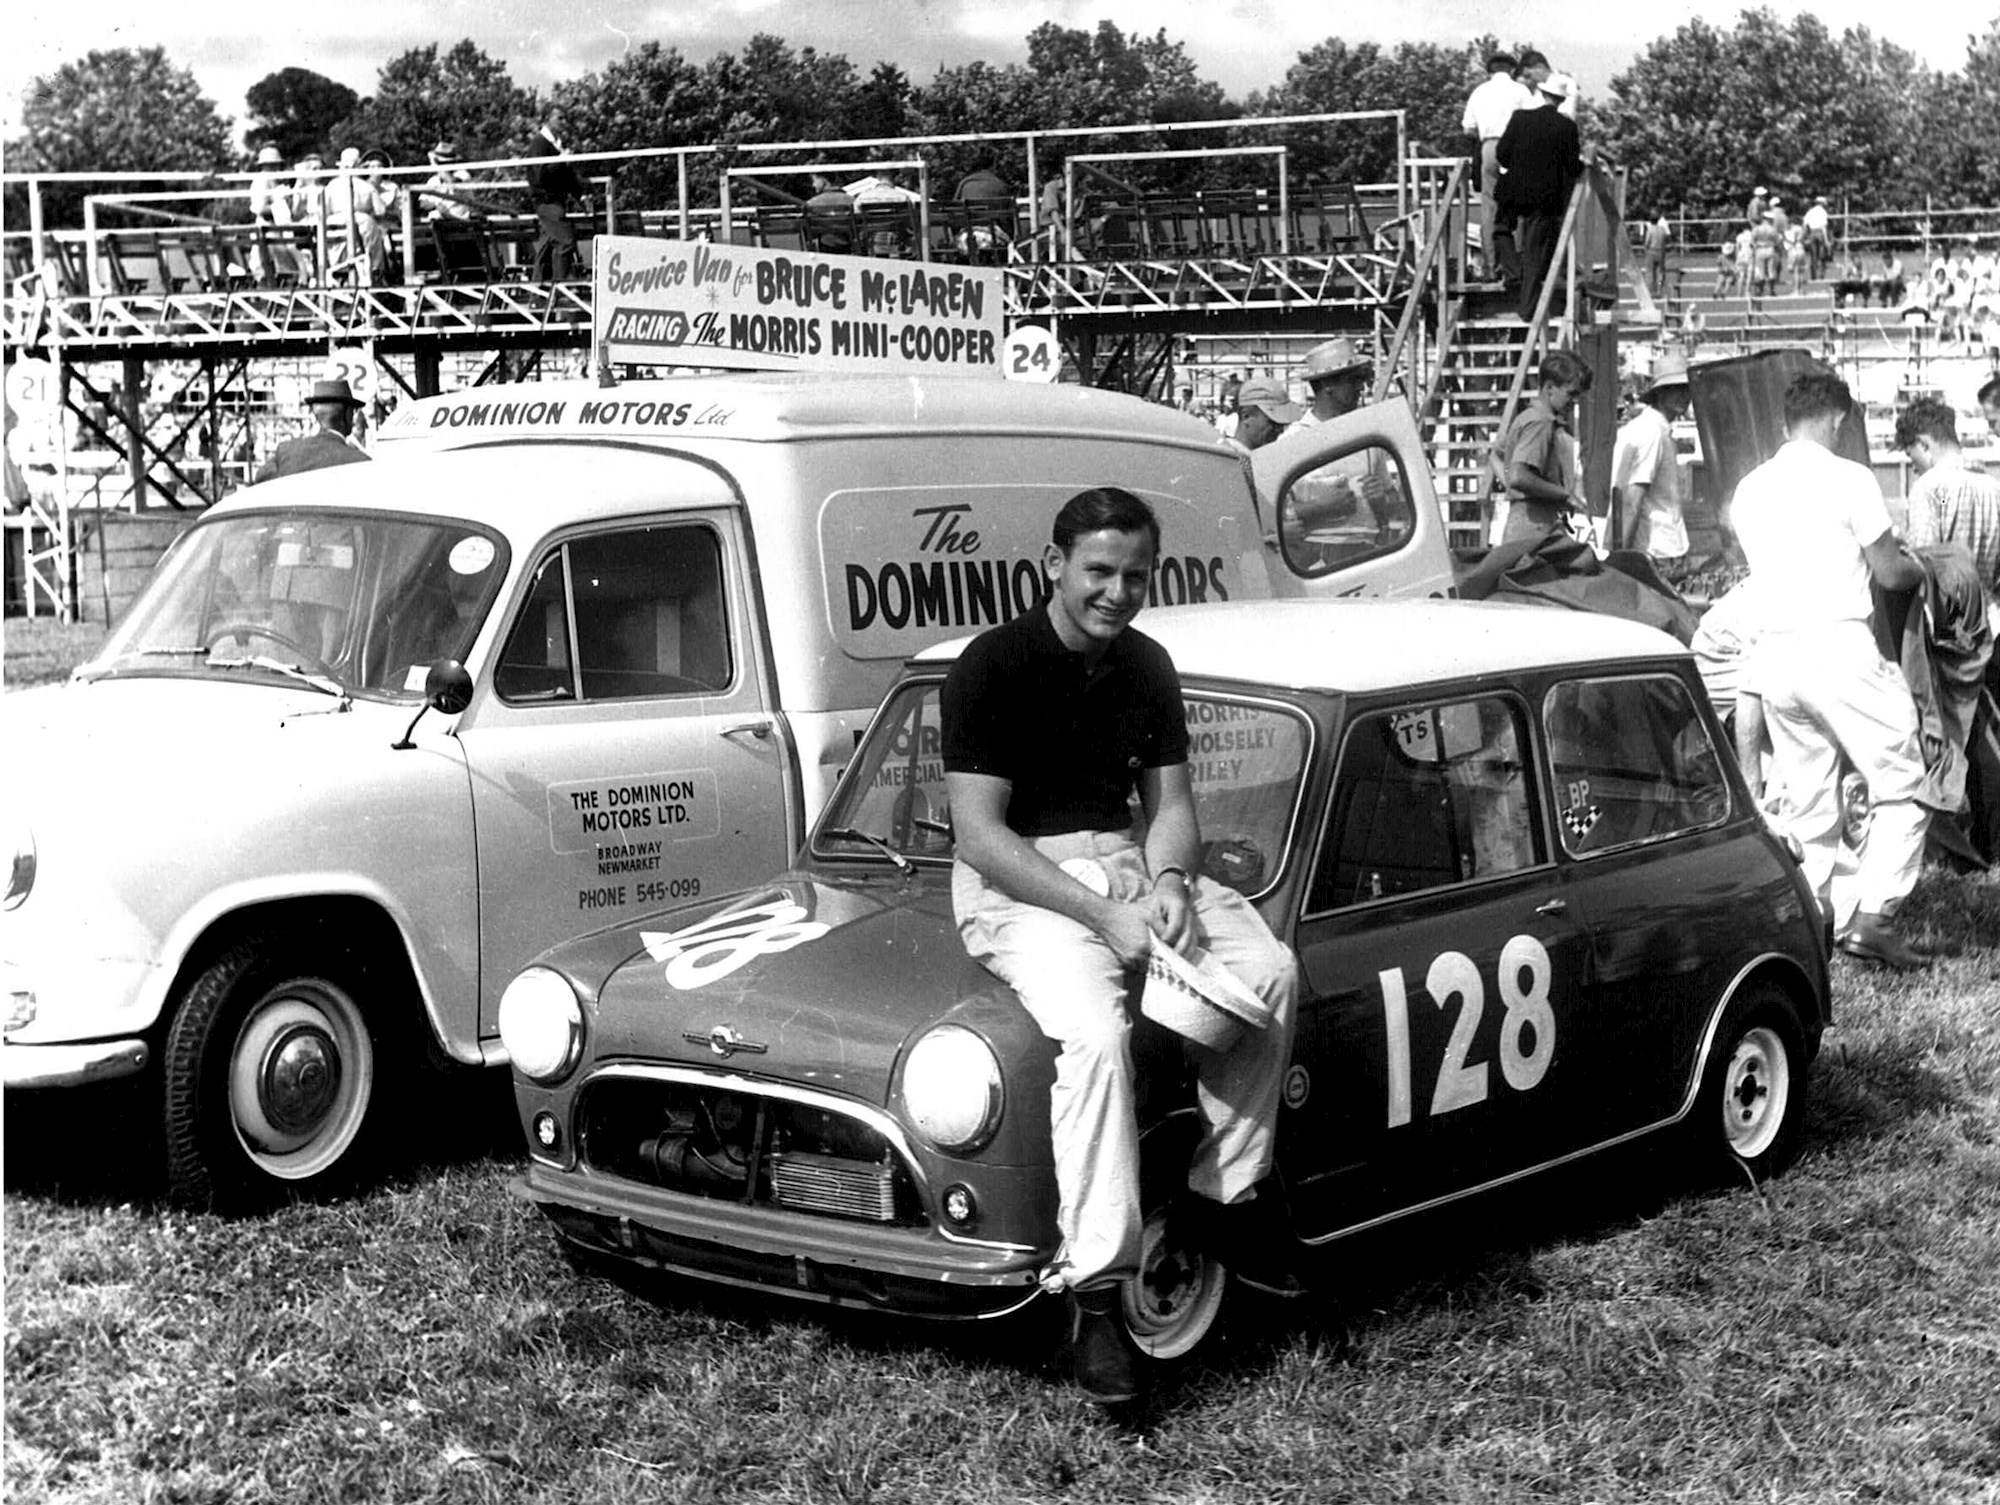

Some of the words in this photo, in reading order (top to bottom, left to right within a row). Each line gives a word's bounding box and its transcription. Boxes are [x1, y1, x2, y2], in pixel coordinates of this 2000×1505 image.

[608, 252, 688, 295] Service
[693, 245, 732, 287] Van
[733, 266, 753, 298] for
[757, 257, 847, 310] BRUCE
[861, 269, 984, 320] McLAREN
[610, 313, 683, 342] RACING
[693, 311, 726, 346] The
[730, 313, 822, 354] MORRIS
[832, 319, 996, 365] MINI-COOPER
[1012, 342, 1052, 374] 24
[22, 375, 46, 401] 21
[336, 362, 367, 391] 22
[430, 402, 567, 428] DOMINION
[578, 401, 693, 426] MOTORS
[693, 403, 737, 426] Ltd
[912, 503, 982, 555] The
[1149, 556, 1230, 608] TORS
[571, 791, 599, 810] THE
[608, 781, 695, 808] DOMINION
[1568, 779, 1590, 809] BP
[582, 808, 651, 833] MOTORS
[658, 804, 690, 825] LTD.
[597, 841, 663, 860] BROADWAY
[598, 857, 662, 876] NEWMARKET
[579, 886, 626, 910] PHONE
[1379, 934, 1556, 1129] 128
